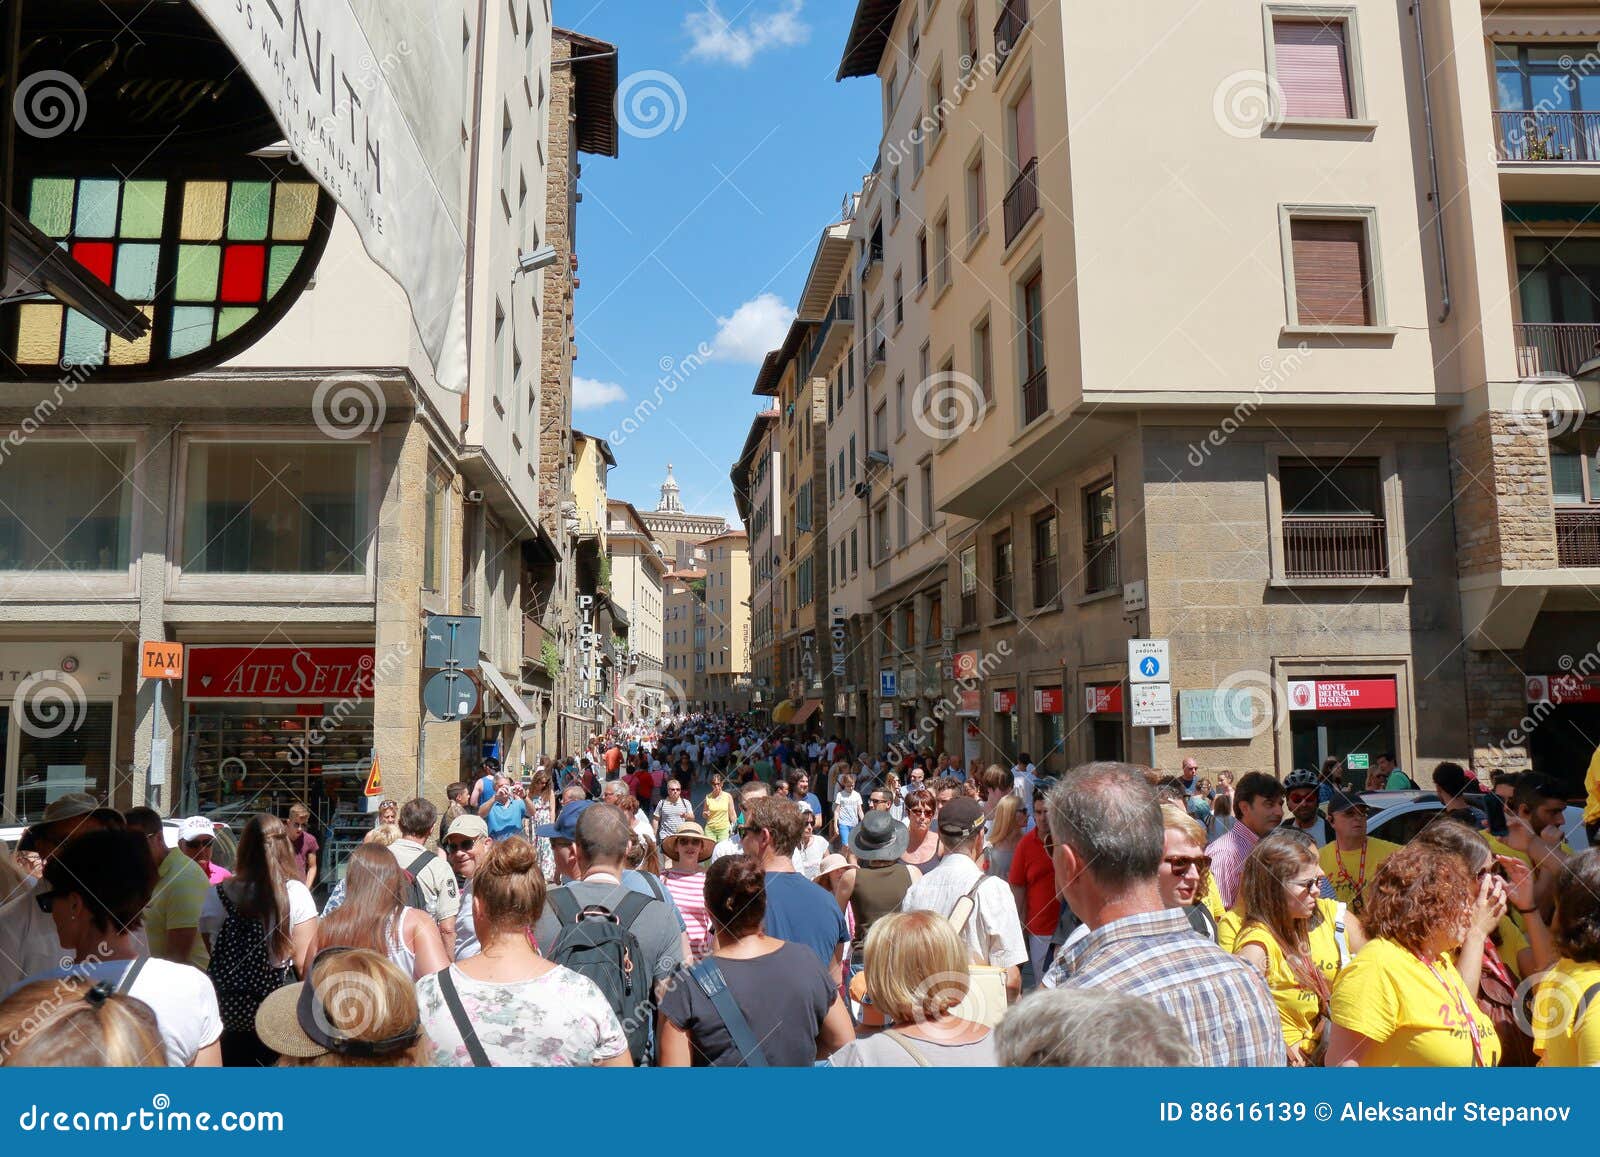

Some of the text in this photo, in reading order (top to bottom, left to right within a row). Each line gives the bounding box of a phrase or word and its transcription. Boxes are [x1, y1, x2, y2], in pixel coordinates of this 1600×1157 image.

[261, 25, 299, 114] WATCH
[307, 110, 384, 235] MANUFACTURE
[278, 99, 305, 157] SINCE
[146, 652, 180, 668] TAXI
[580, 595, 593, 695] PICCINI
[831, 605, 846, 676] GLOVES
[576, 698, 594, 708] UGO
